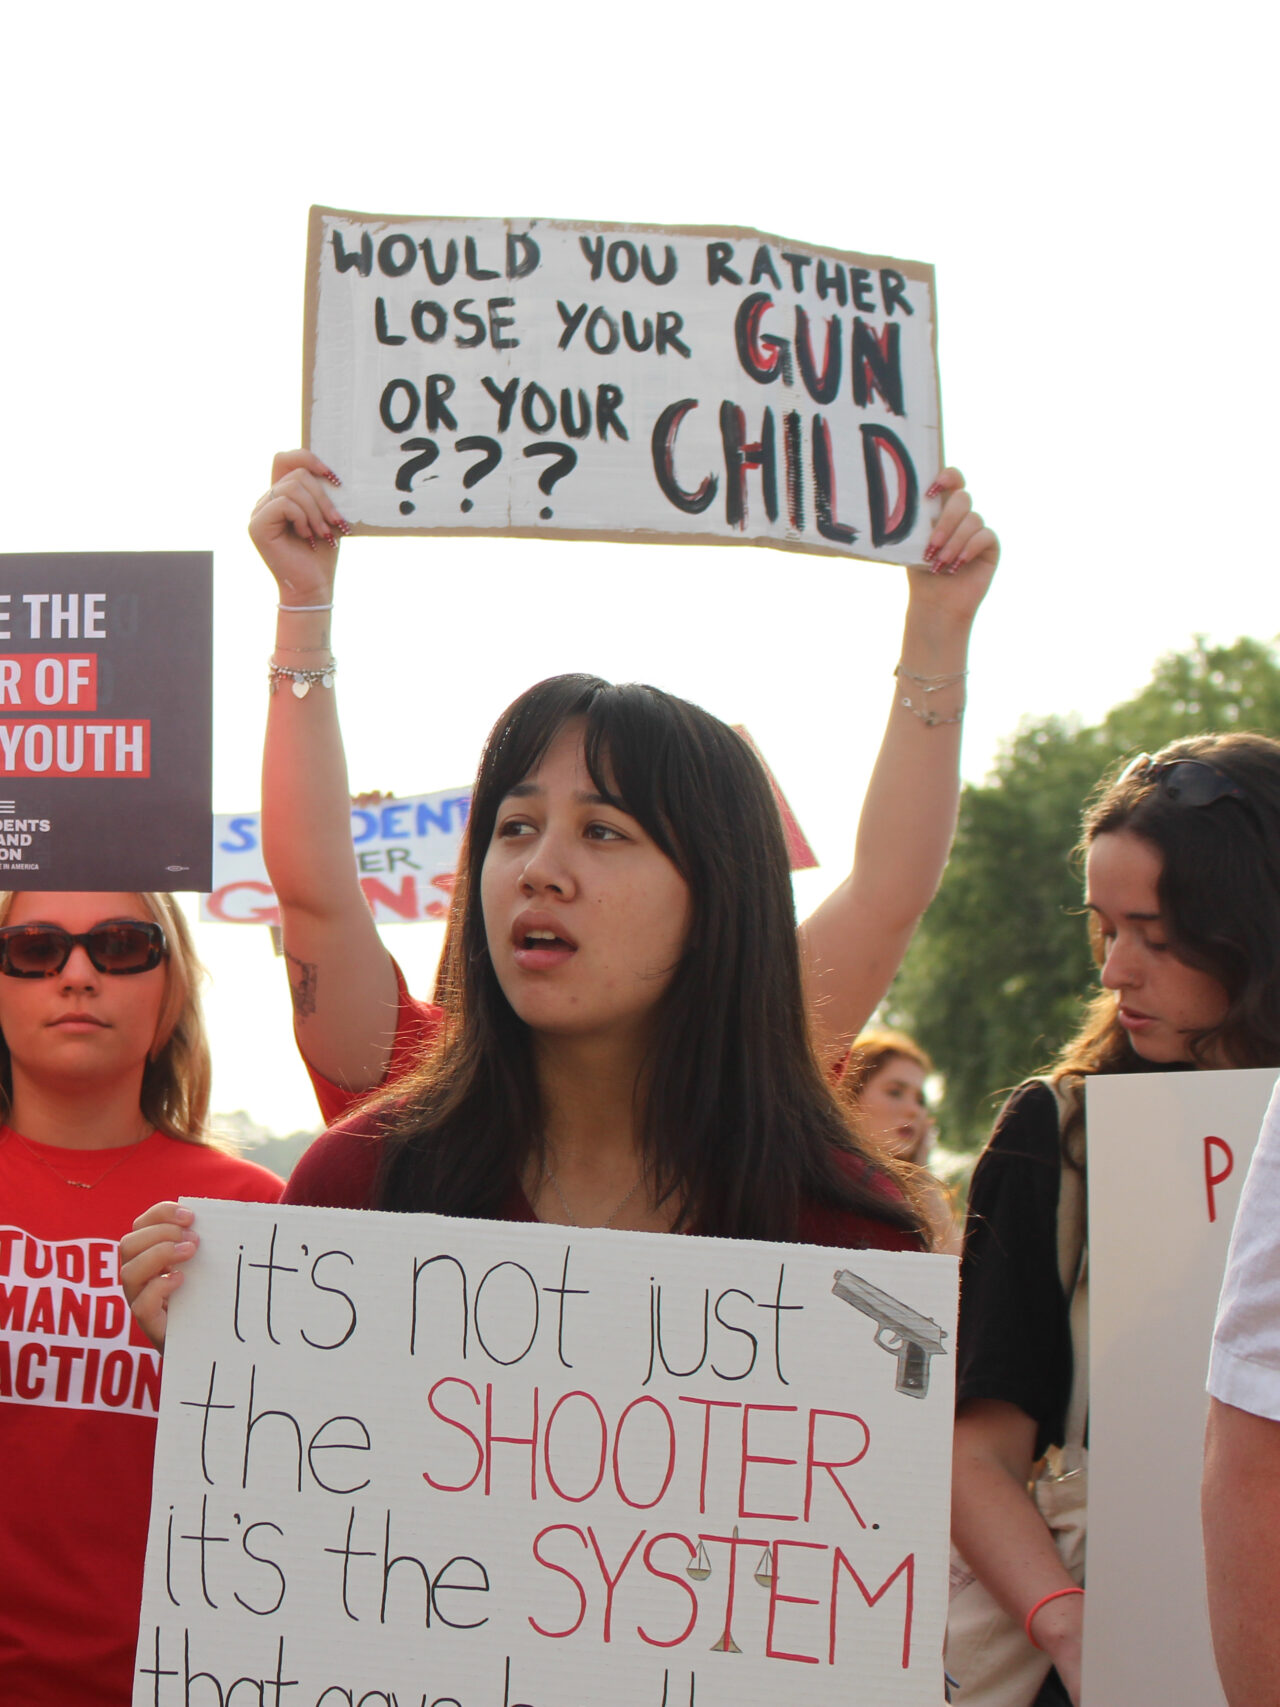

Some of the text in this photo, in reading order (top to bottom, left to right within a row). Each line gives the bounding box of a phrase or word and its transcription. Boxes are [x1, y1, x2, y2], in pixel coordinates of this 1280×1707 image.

[332, 229, 914, 317] WOULD YOU RATHER
[375, 292, 906, 416] LOSE YOUR GUN
[379, 374, 919, 548] OR YOUR CHILD
[22, 593, 107, 639] THE
[34, 658, 90, 705] OF
[220, 796, 472, 853] SDENT
[206, 873, 457, 924] GNS
[232, 1223, 805, 1385] it's not just
[180, 1360, 882, 1531] the SHOOTER.
[165, 1494, 915, 1668] it's the SYSTEM
